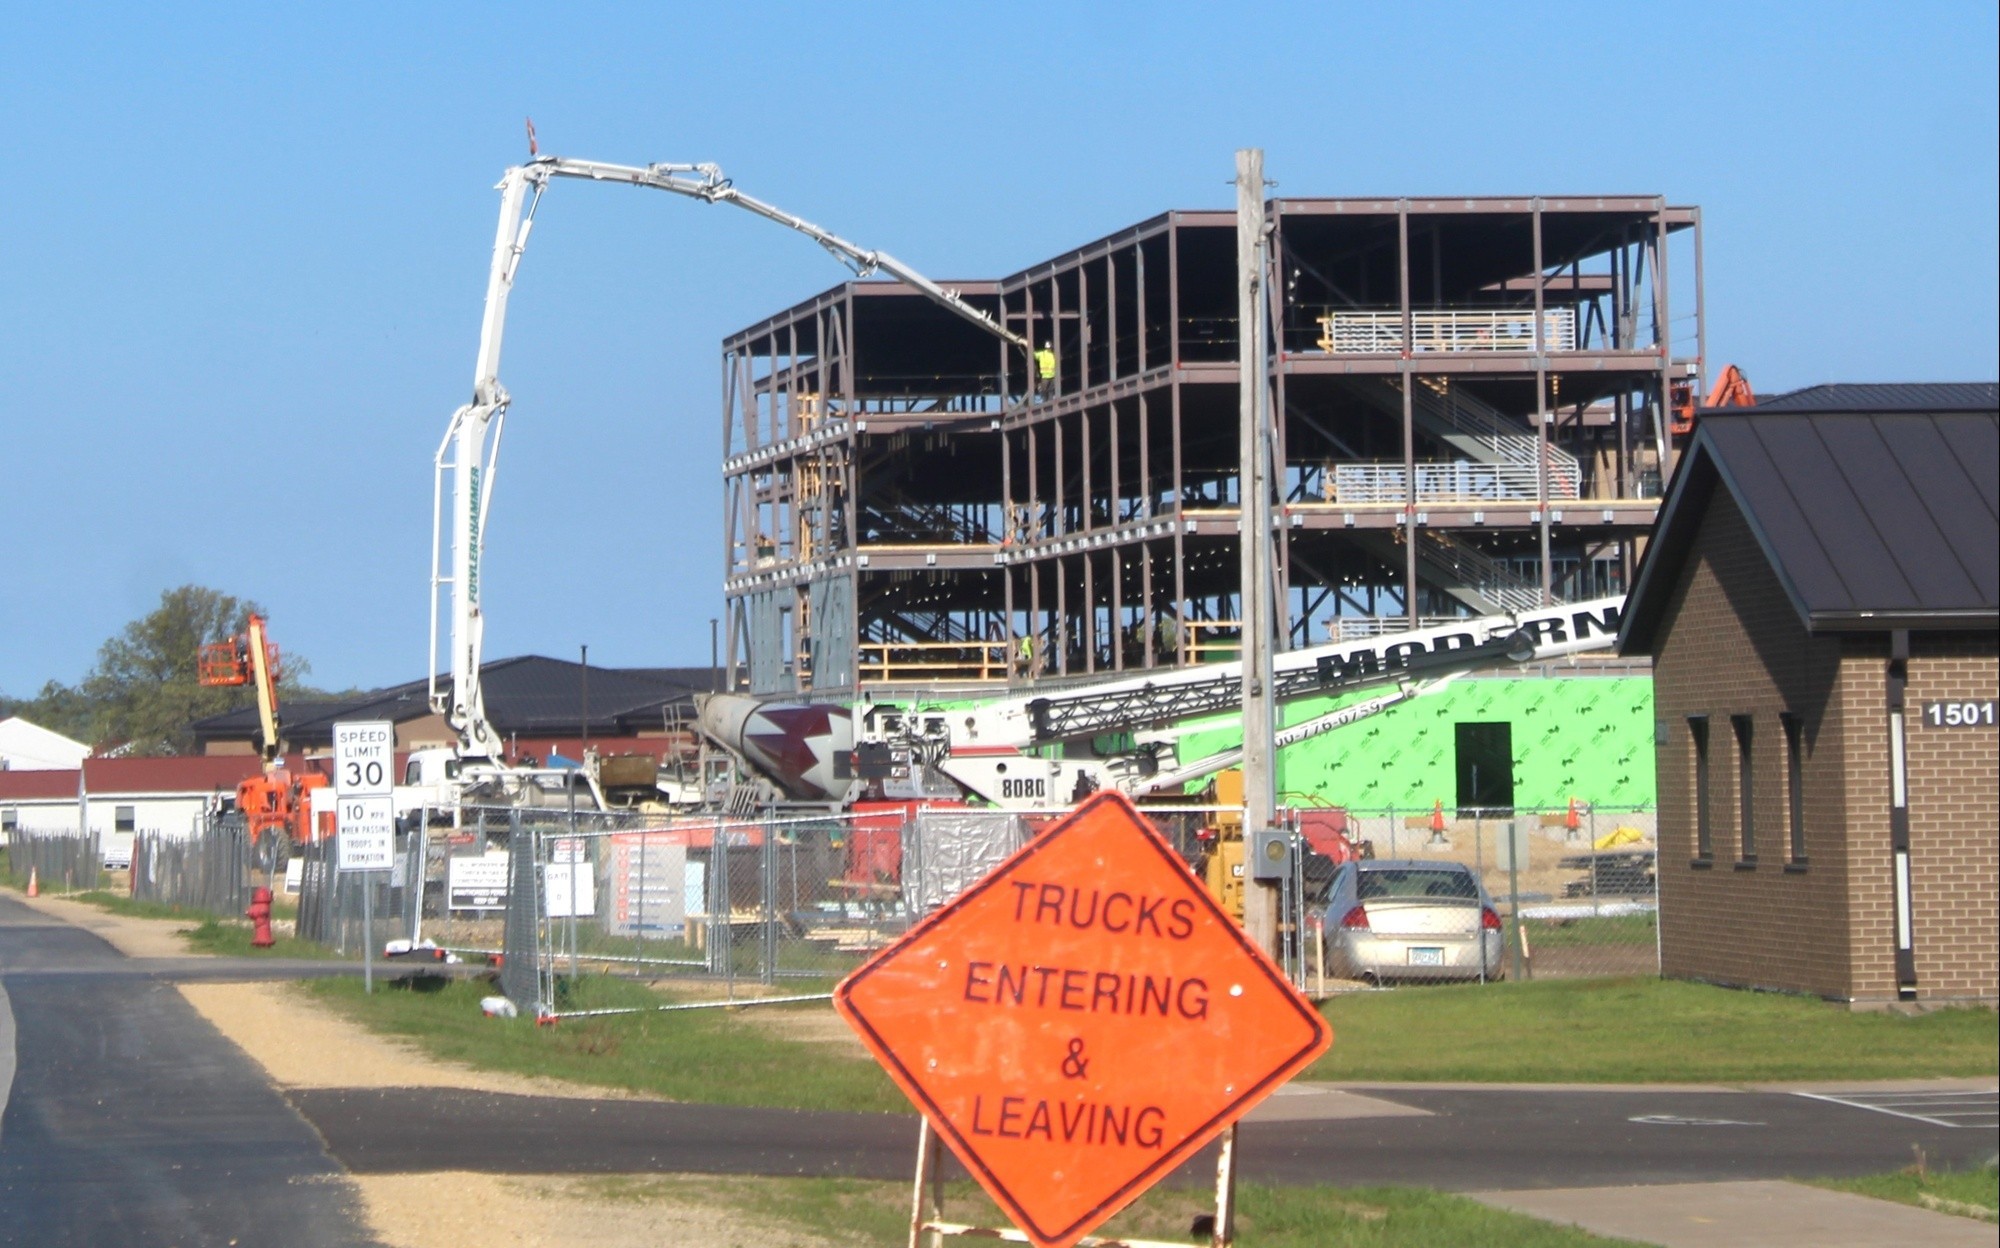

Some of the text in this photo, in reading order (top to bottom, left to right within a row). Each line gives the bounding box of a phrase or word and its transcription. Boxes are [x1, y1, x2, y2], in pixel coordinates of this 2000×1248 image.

[1928, 702, 1993, 725] 1501
[340, 731, 387, 743] SPEED
[345, 746, 381, 758] LIMIT
[346, 761, 383, 787] 30
[1002, 778, 1045, 798] 8080
[346, 804, 385, 821] 10 MPH
[341, 825, 390, 835] WHEN PASSING
[347, 839, 385, 848] TROOPS IN
[347, 853, 385, 863] FORMATION
[1011, 880, 1195, 940] TRUCKS
[963, 961, 1210, 1021] ENTERING
[1061, 1037, 1091, 1081] &
[971, 1095, 1166, 1150] LEAVING
